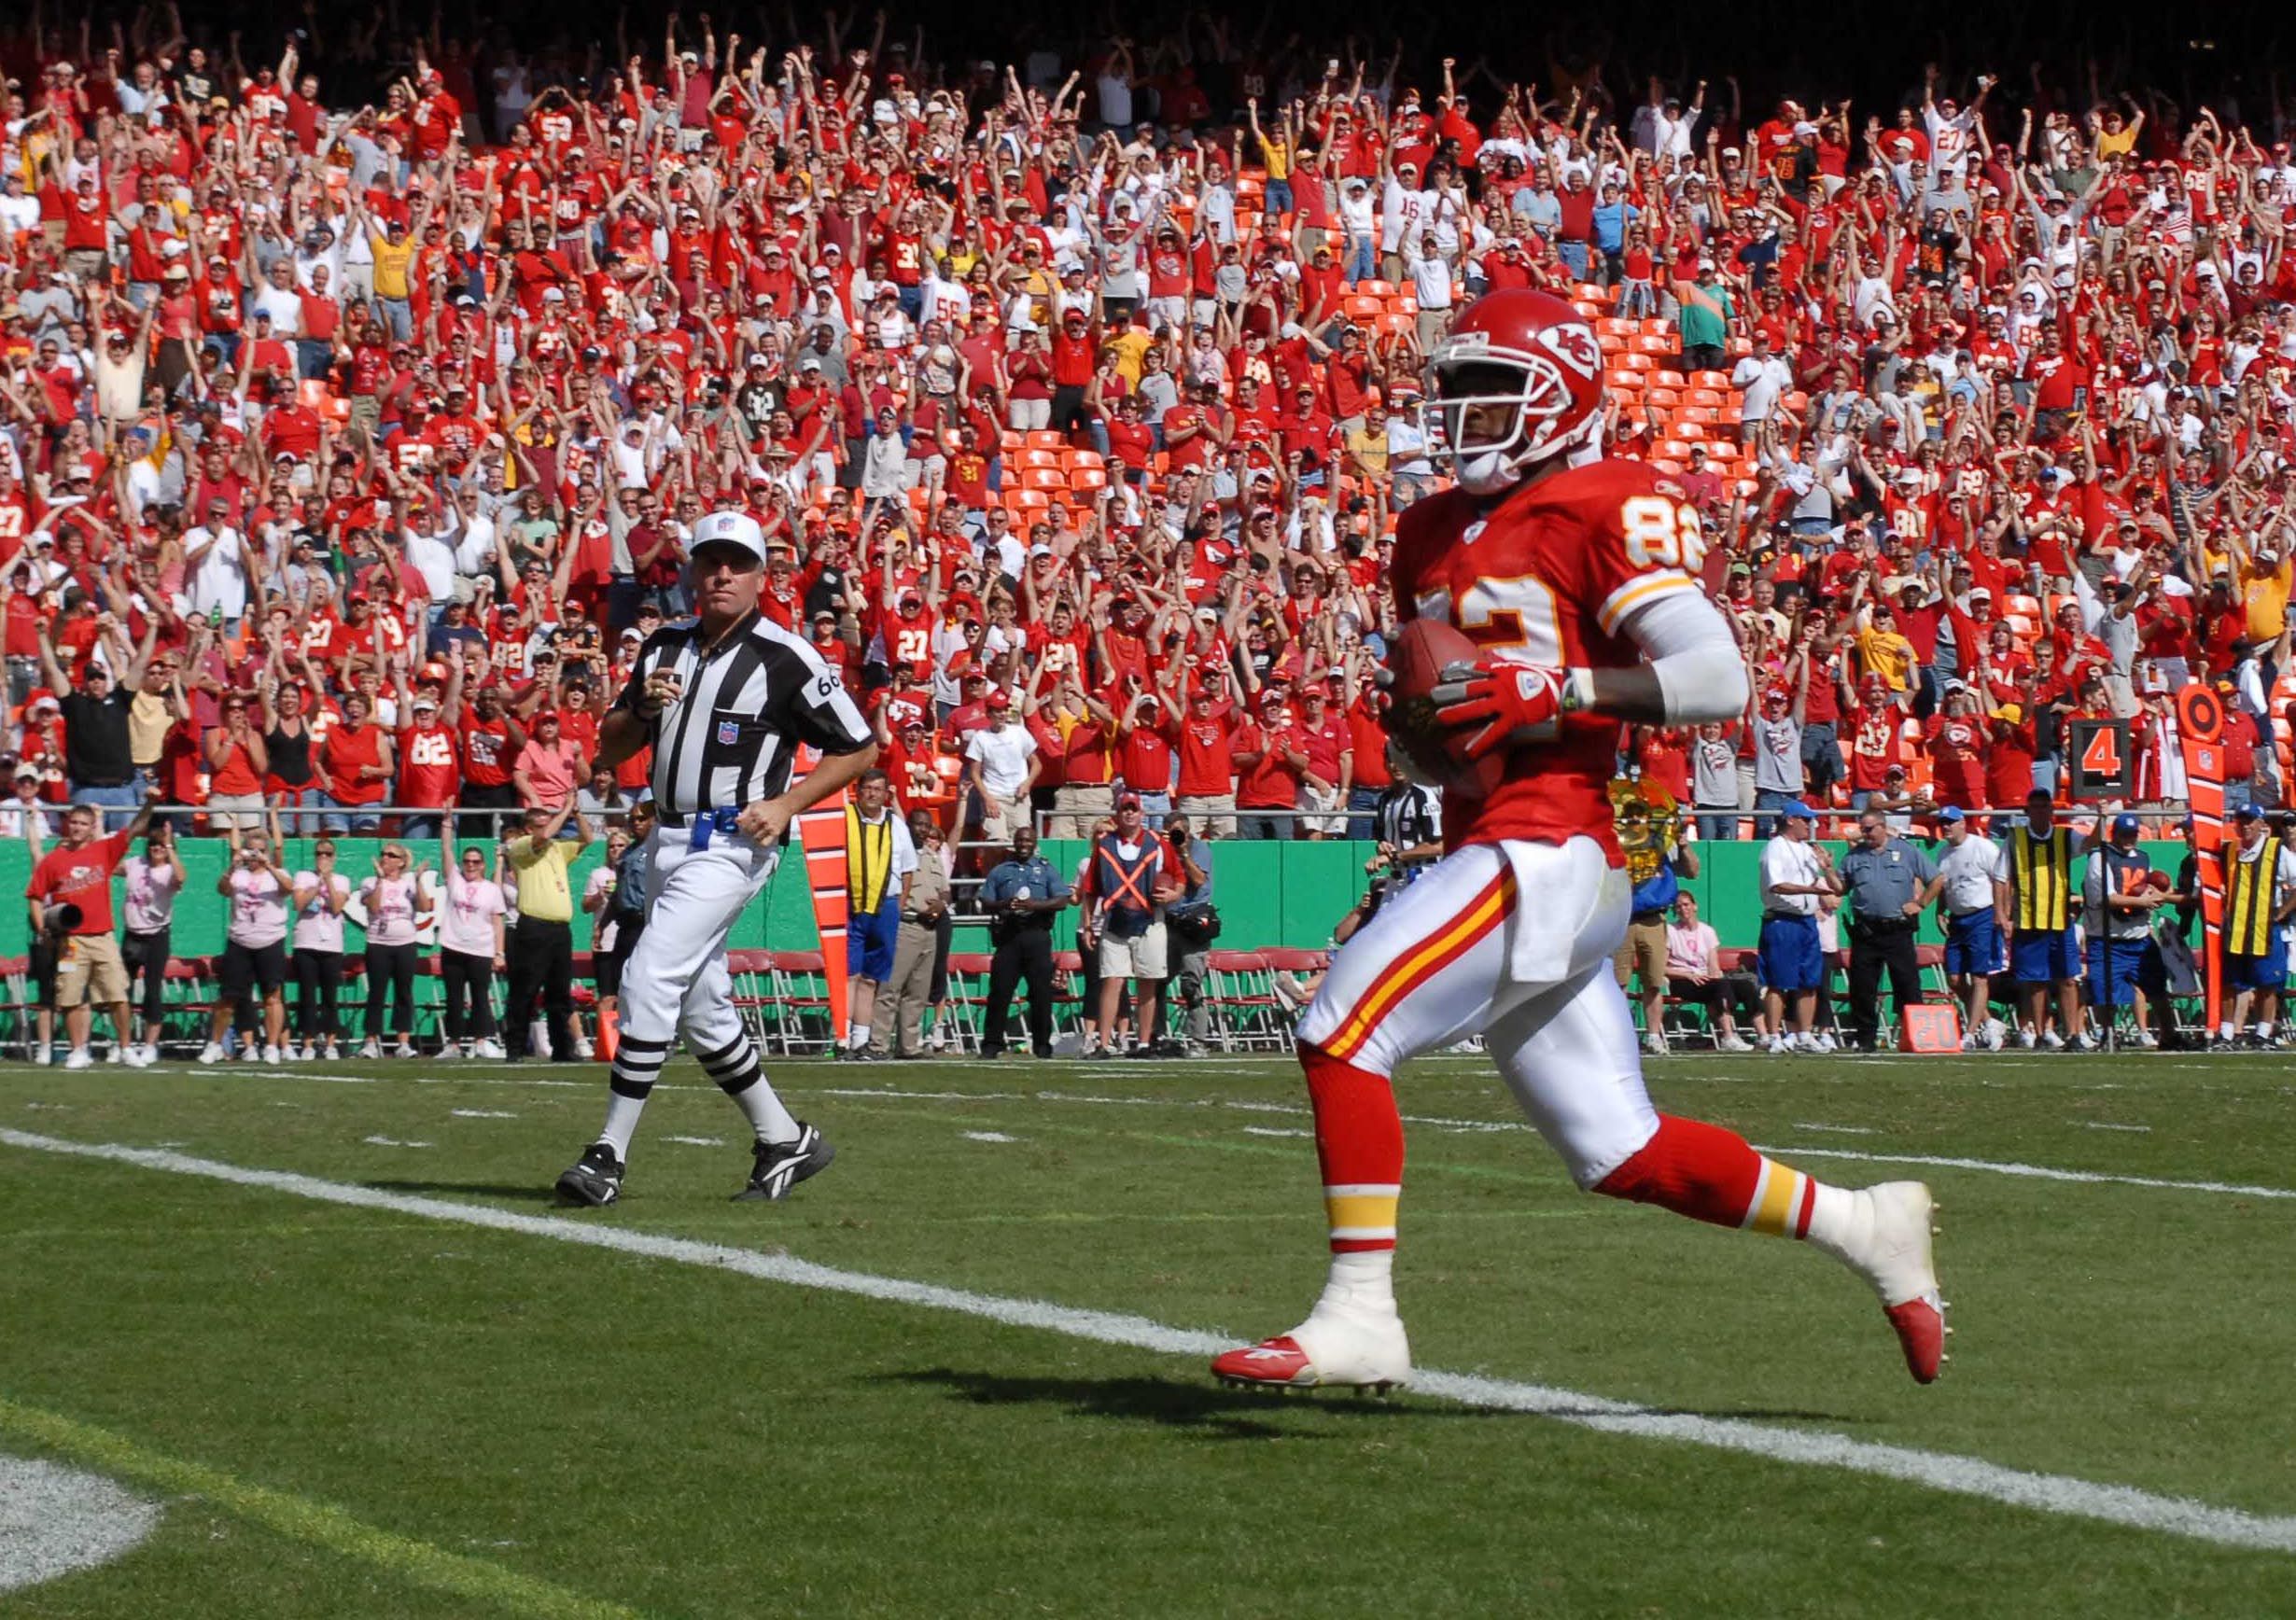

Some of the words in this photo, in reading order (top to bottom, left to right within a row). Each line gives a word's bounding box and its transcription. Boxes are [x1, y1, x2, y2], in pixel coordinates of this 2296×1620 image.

[1937, 129, 1962, 150] 27
[897, 630, 929, 661] 27
[2080, 725, 2122, 778] 4
[1910, 1010, 1957, 1049] 20
